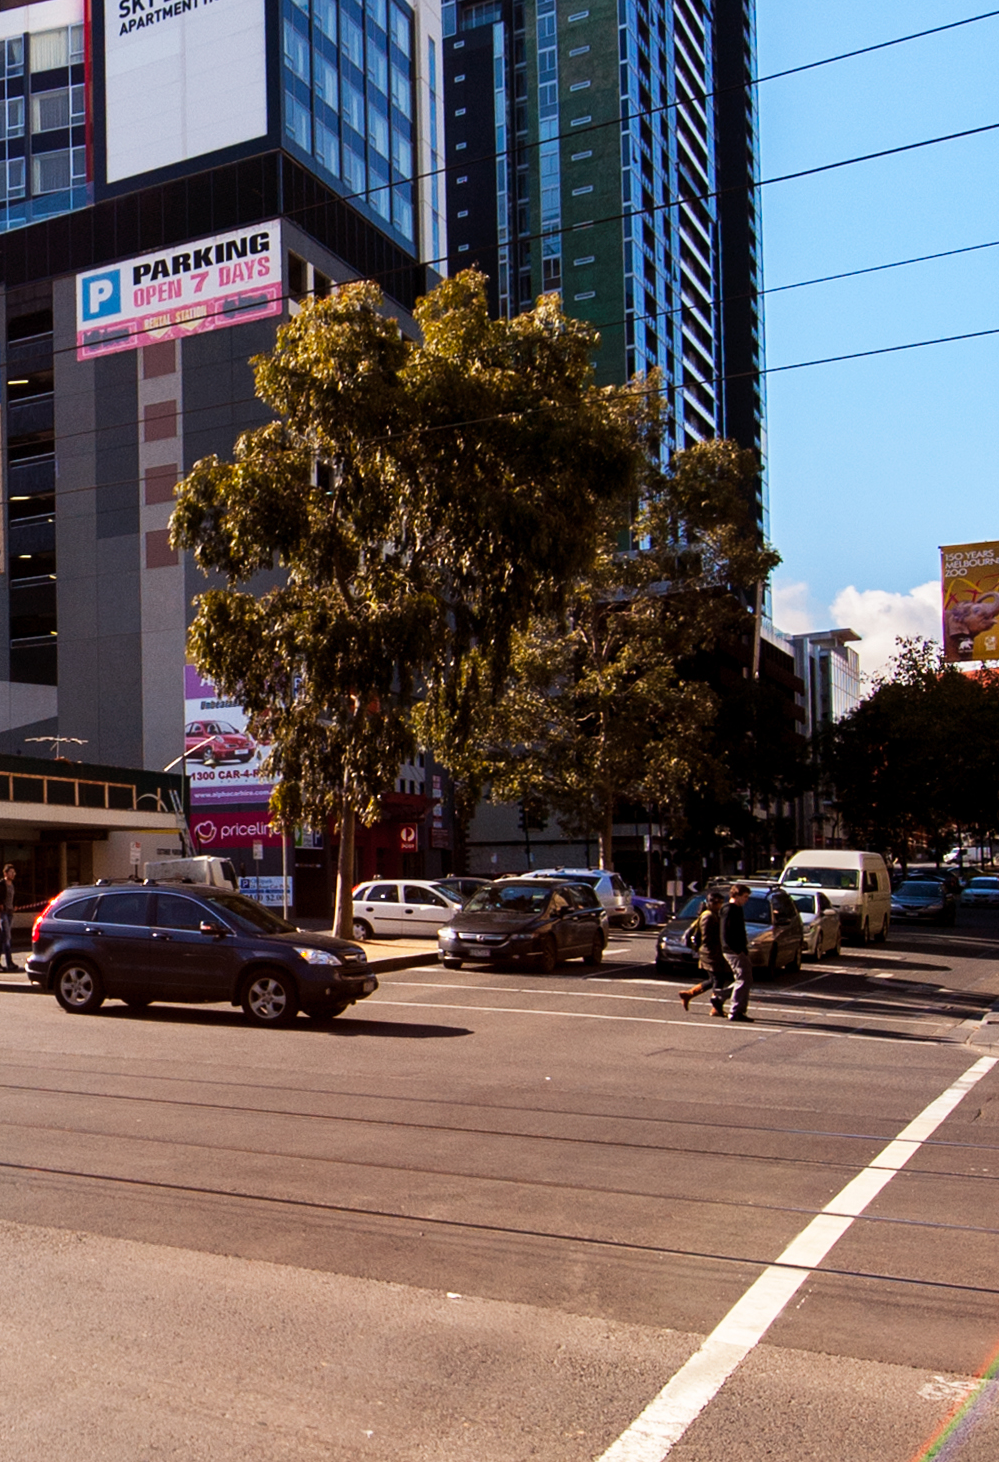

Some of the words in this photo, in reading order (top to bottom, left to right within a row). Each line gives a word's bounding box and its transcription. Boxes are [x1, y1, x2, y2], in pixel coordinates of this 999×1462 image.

[132, 231, 270, 286] PARKING
[133, 278, 182, 308] OPEN
[190, 271, 210, 294] 7
[218, 255, 270, 288] DAYS
[89, 278, 113, 314] P
[175, 304, 207, 323] STATION
[944, 552, 963, 562] 150
[965, 549, 994, 559] YEARS
[944, 568, 968, 578] ZOO
[190, 770, 216, 781] 1300
